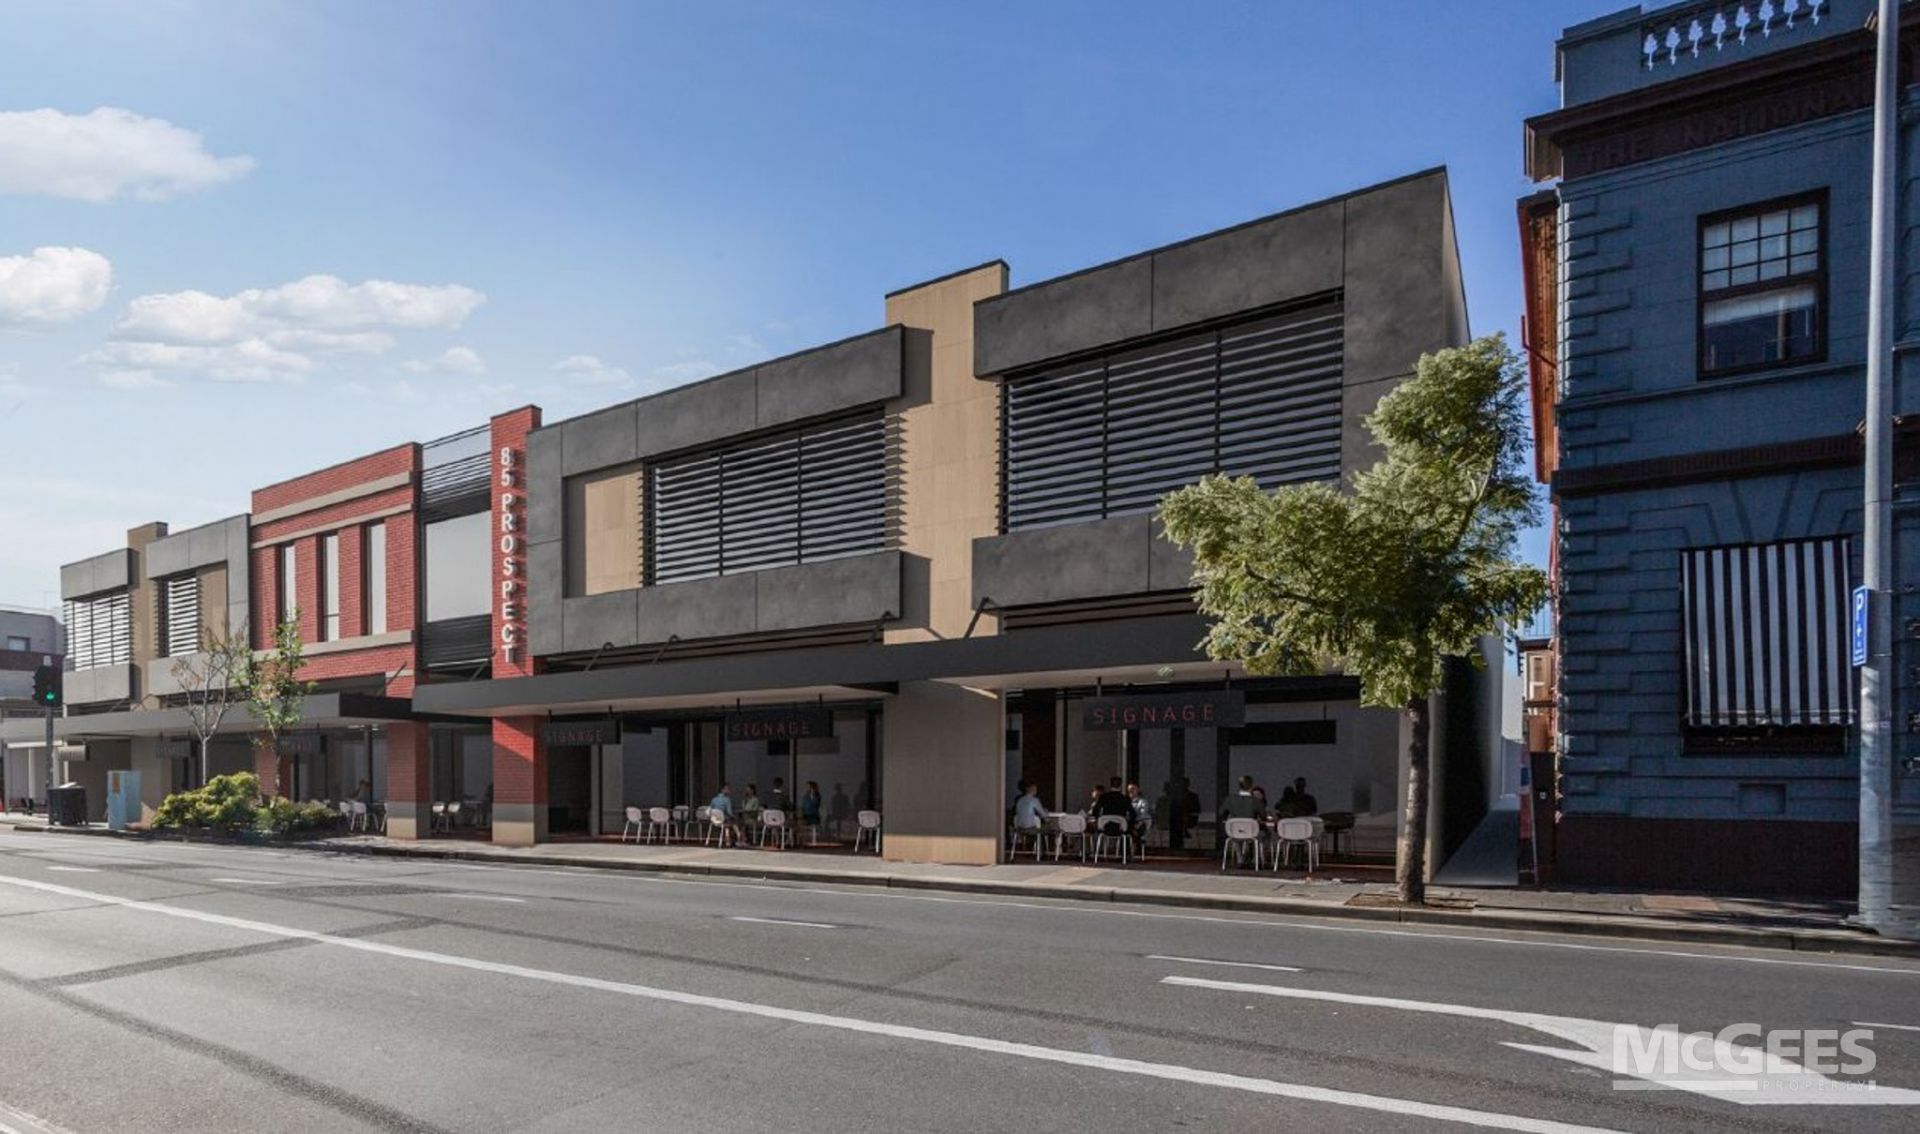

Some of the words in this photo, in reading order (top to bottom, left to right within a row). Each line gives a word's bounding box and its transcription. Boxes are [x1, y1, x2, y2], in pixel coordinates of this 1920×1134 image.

[1583, 131, 1650, 170] THE
[500, 447, 513, 487] 85
[500, 493, 514, 663] PROSPECT
[1855, 593, 1864, 621] P
[729, 719, 809, 738] SIGNAGE
[1093, 703, 1214, 725] SIGNAGE
